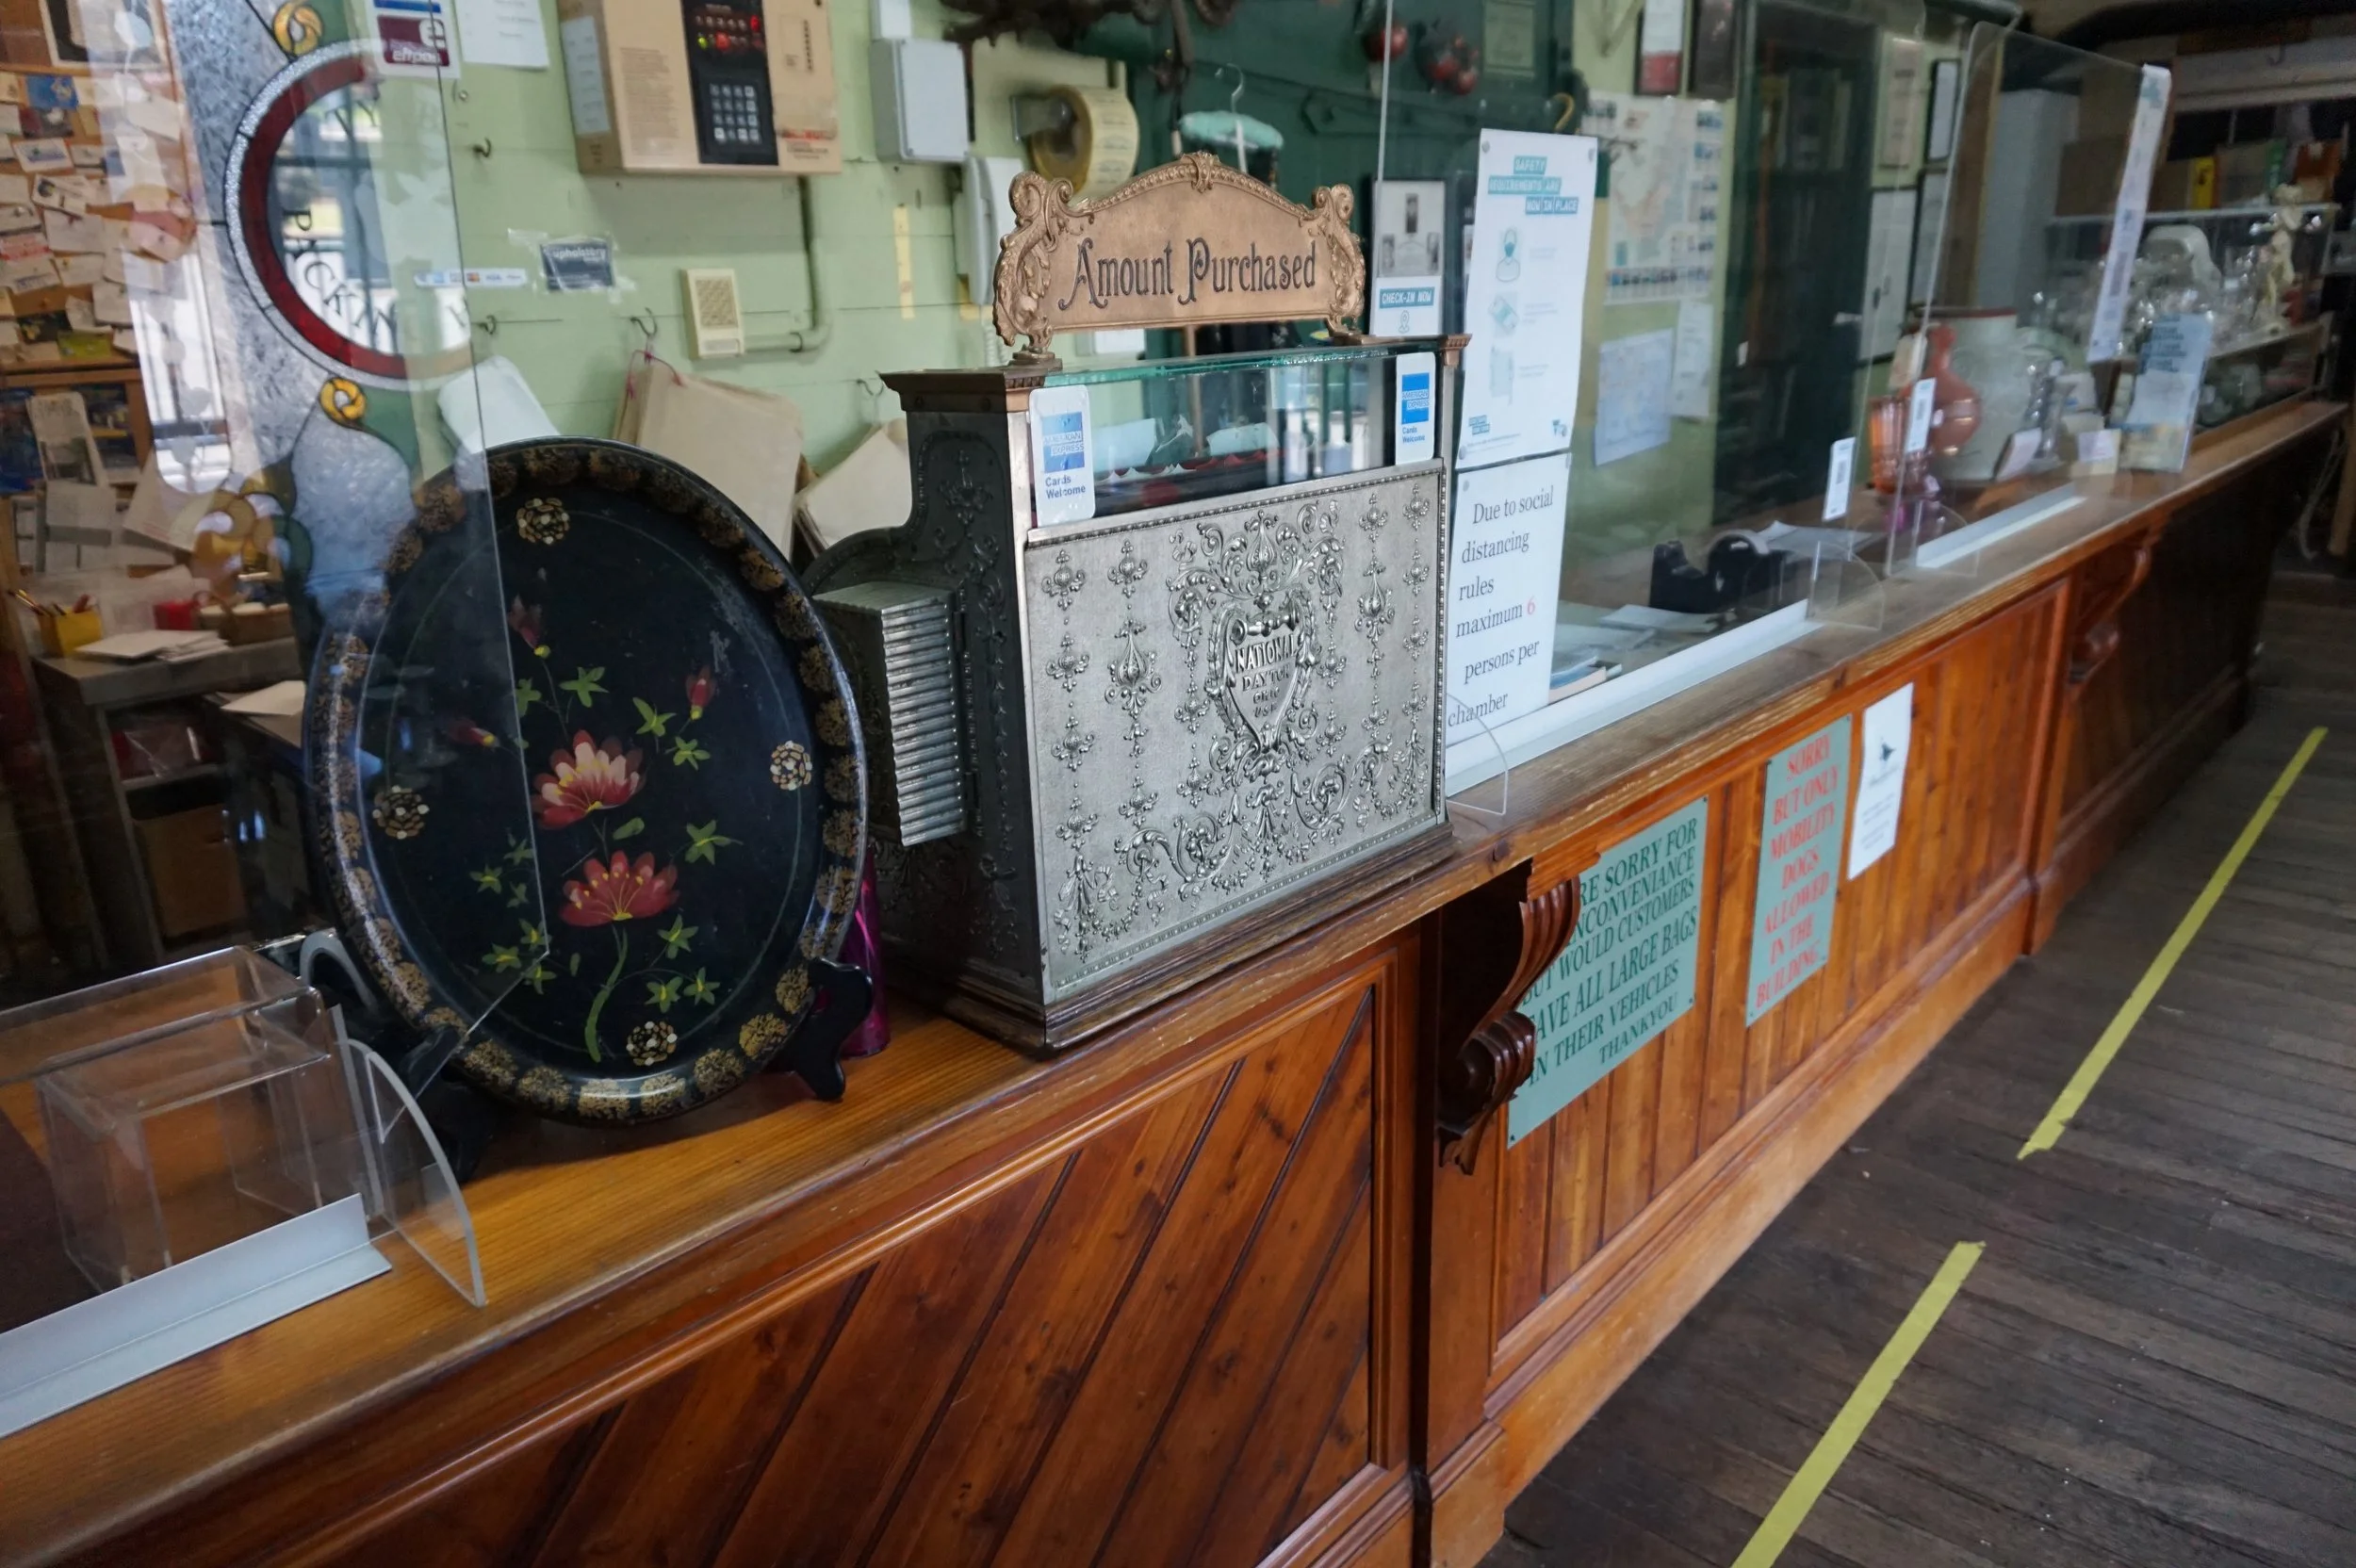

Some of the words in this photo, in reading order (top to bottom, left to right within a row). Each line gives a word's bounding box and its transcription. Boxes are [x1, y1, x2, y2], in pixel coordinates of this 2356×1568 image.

[1555, 198, 1578, 211] PLACE
[1058, 237, 1174, 311] Amount
[1178, 237, 1317, 305] Purchased
[1382, 290, 1415, 305] CHECK-IN
[1417, 289, 1432, 303] NOW
[1402, 389, 1429, 400] AMERICAN
[1407, 400, 1430, 409] EXPRESS
[1052, 443, 1085, 456] EXPRESS
[1402, 434, 1425, 444] Welcome
[1045, 474, 1072, 487] Cards
[1046, 485, 1086, 499] Welcome
[1472, 502, 1500, 525] Due
[1504, 498, 1516, 517] to
[1518, 484, 1554, 514] social
[1462, 531, 1530, 564] distancing
[1459, 575, 1495, 601] rules
[1455, 603, 1523, 638] maximum
[1527, 596, 1536, 615] 6
[1235, 634, 1297, 674] NATIONAL
[1464, 648, 1514, 685] persons
[1517, 641, 1540, 666] per
[1243, 663, 1290, 692] DAYTON
[1448, 693, 1509, 727] chamber
[1787, 732, 1831, 776] SORRY
[1773, 787, 1800, 825] BUT
[1804, 764, 1839, 807] ONLY
[1770, 801, 1835, 860] MOBILITY
[1579, 874, 1600, 906] RE
[1604, 837, 1662, 893] SORRY
[1666, 817, 1697, 857] FOR
[1782, 846, 1820, 890] DOGS
[1568, 845, 1695, 944] NCONVENIANCE
[1764, 871, 1829, 935] ALLOWED
[1559, 926, 1614, 981] WOULD
[1618, 873, 1694, 943] CUSTOMERS
[1770, 938, 1785, 965] IN
[1789, 913, 1814, 951] THE
[1573, 969, 1604, 1019] ALL
[1608, 932, 1660, 994] LARGE
[1661, 905, 1697, 956] BAGS
[1755, 942, 1820, 1009] BUILDING
[1554, 1013, 1604, 1068] THEIR
[1610, 958, 1679, 1026] VEHICLES
[1599, 992, 1678, 1065] THANKYOU
